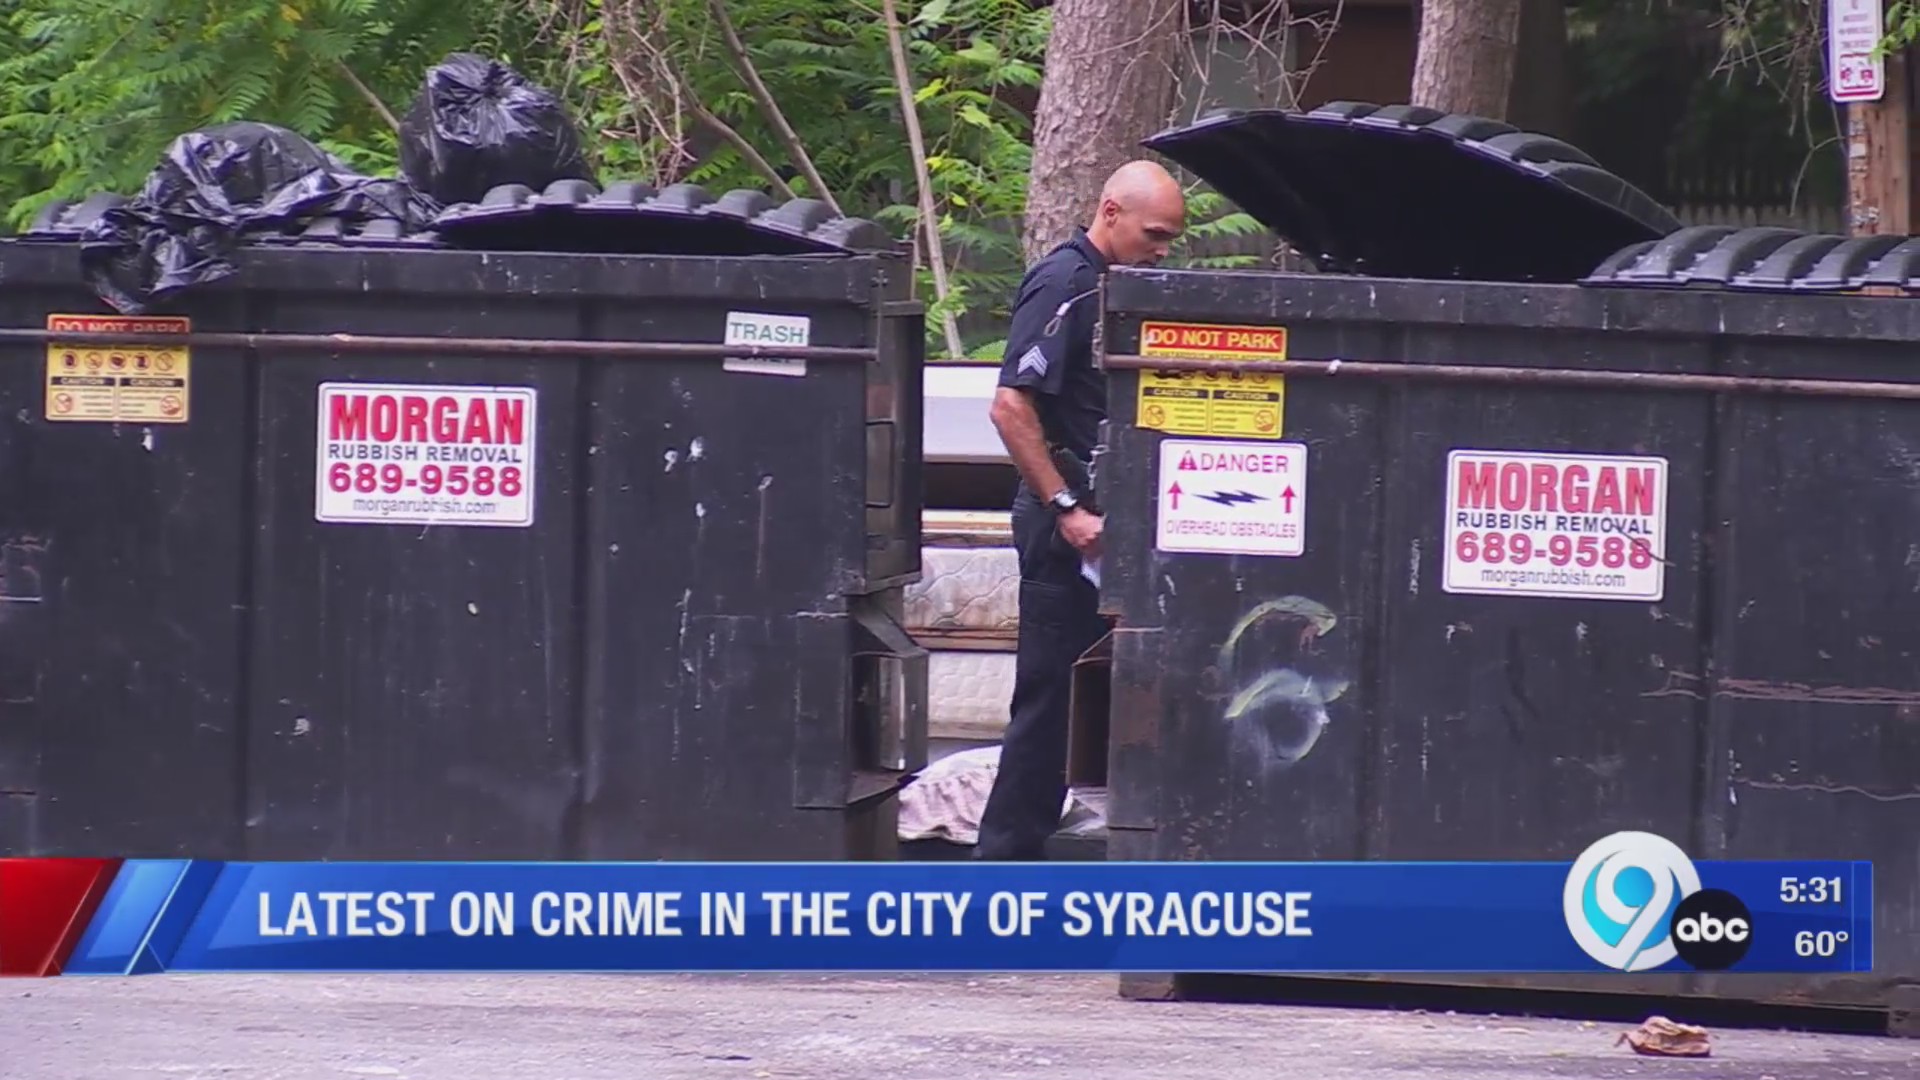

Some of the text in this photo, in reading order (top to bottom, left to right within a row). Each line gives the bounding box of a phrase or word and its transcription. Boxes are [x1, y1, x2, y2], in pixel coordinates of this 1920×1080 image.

[730, 322, 804, 343] TRASH
[1150, 328, 1280, 350] DO NOT PARK
[1153, 388, 1199, 397] CAUTION
[1223, 391, 1269, 400] CAUTION
[329, 394, 524, 445] MORGAN
[328, 444, 522, 463] RUBBISH REMOVAL
[1201, 453, 1289, 473] DANGER
[328, 462, 522, 497] 689-9588
[1458, 461, 1655, 515] MORGAN
[1166, 519, 1297, 539] OVERHEAD OBSTACLES
[1456, 512, 1653, 535] RUBBISH REMOVAL
[1456, 531, 1653, 569] 689-9588
[1481, 568, 1626, 587] morganrubbish.com
